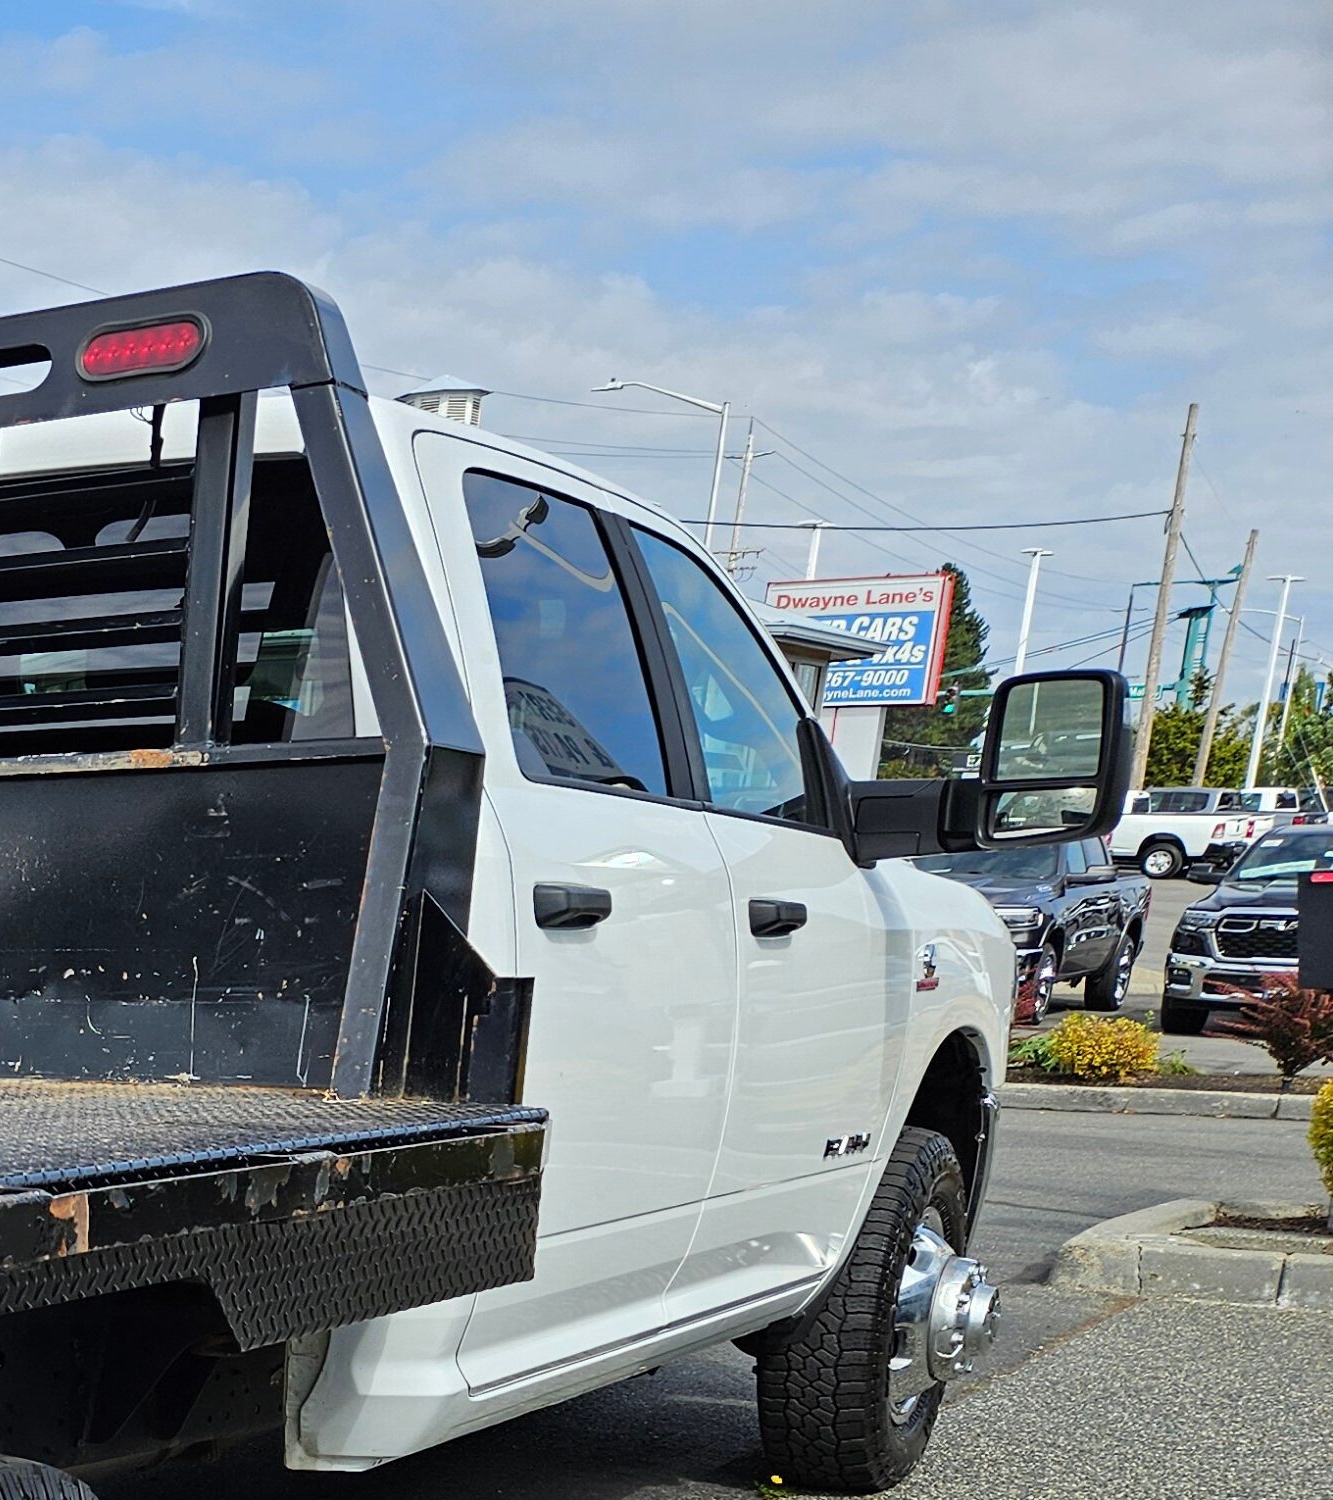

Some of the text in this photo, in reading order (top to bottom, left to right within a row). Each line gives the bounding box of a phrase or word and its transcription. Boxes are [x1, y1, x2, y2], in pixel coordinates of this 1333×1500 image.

[776, 587, 934, 611] Dwayne Lane's
[850, 615, 919, 642] CARS
[823, 687, 911, 701] yneLane.com
